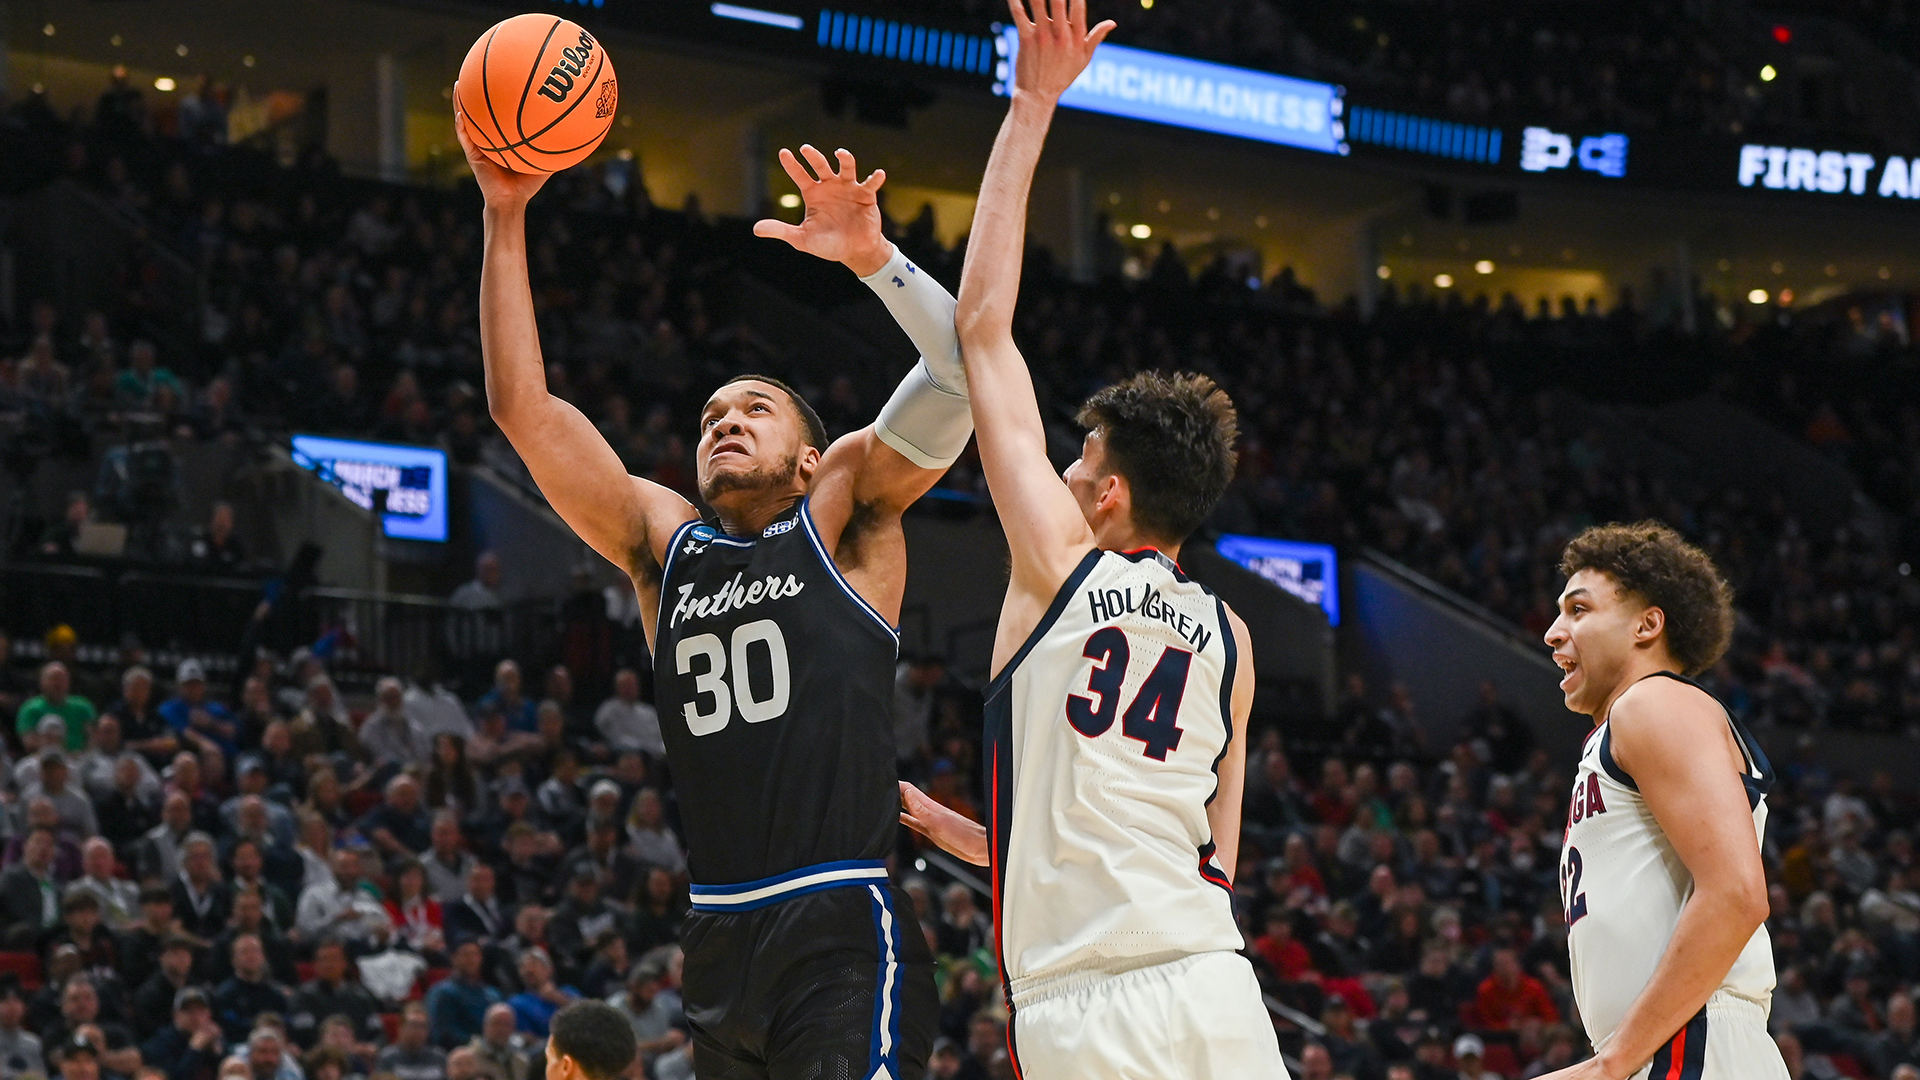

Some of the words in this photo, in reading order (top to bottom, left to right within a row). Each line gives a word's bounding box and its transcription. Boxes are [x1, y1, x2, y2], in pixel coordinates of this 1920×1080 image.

[537, 29, 595, 103] Wilson
[1071, 60, 1326, 134] ARCHMADNESS
[1738, 144, 1875, 195] FIRST
[693, 529, 714, 540] NCAA
[676, 619, 790, 736] 30
[1066, 626, 1193, 762] 34
